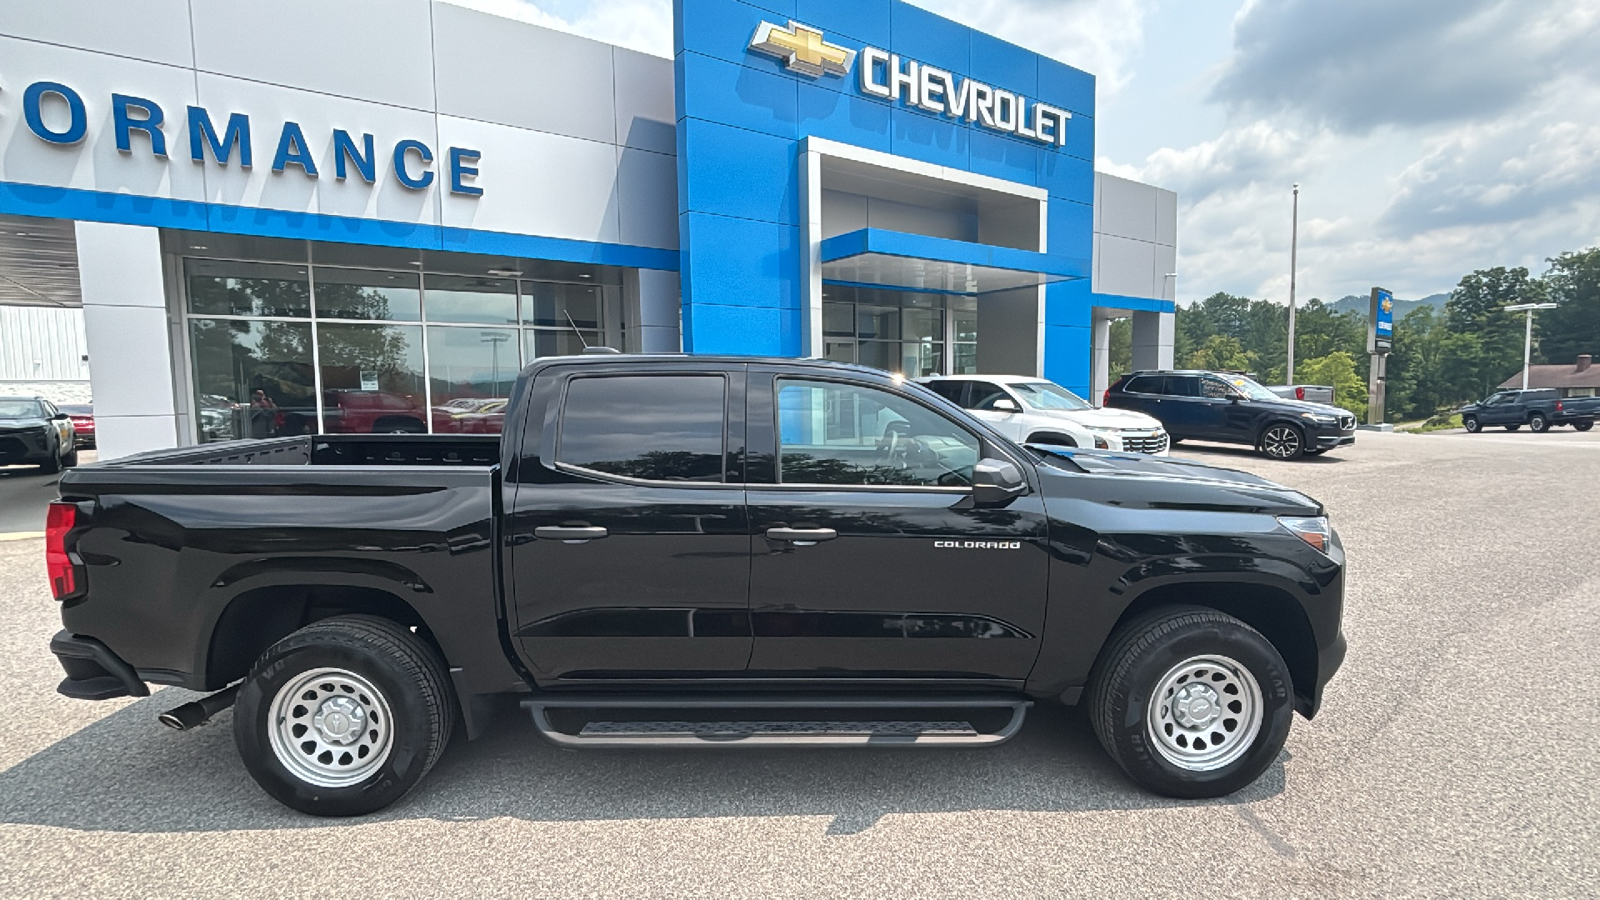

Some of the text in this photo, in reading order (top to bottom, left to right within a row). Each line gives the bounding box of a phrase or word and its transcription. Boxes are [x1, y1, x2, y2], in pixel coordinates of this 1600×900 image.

[0, 81, 484, 198] ORMANCE
[860, 46, 1072, 147] CHEVROLET
[934, 540, 1021, 549] COLORADO
